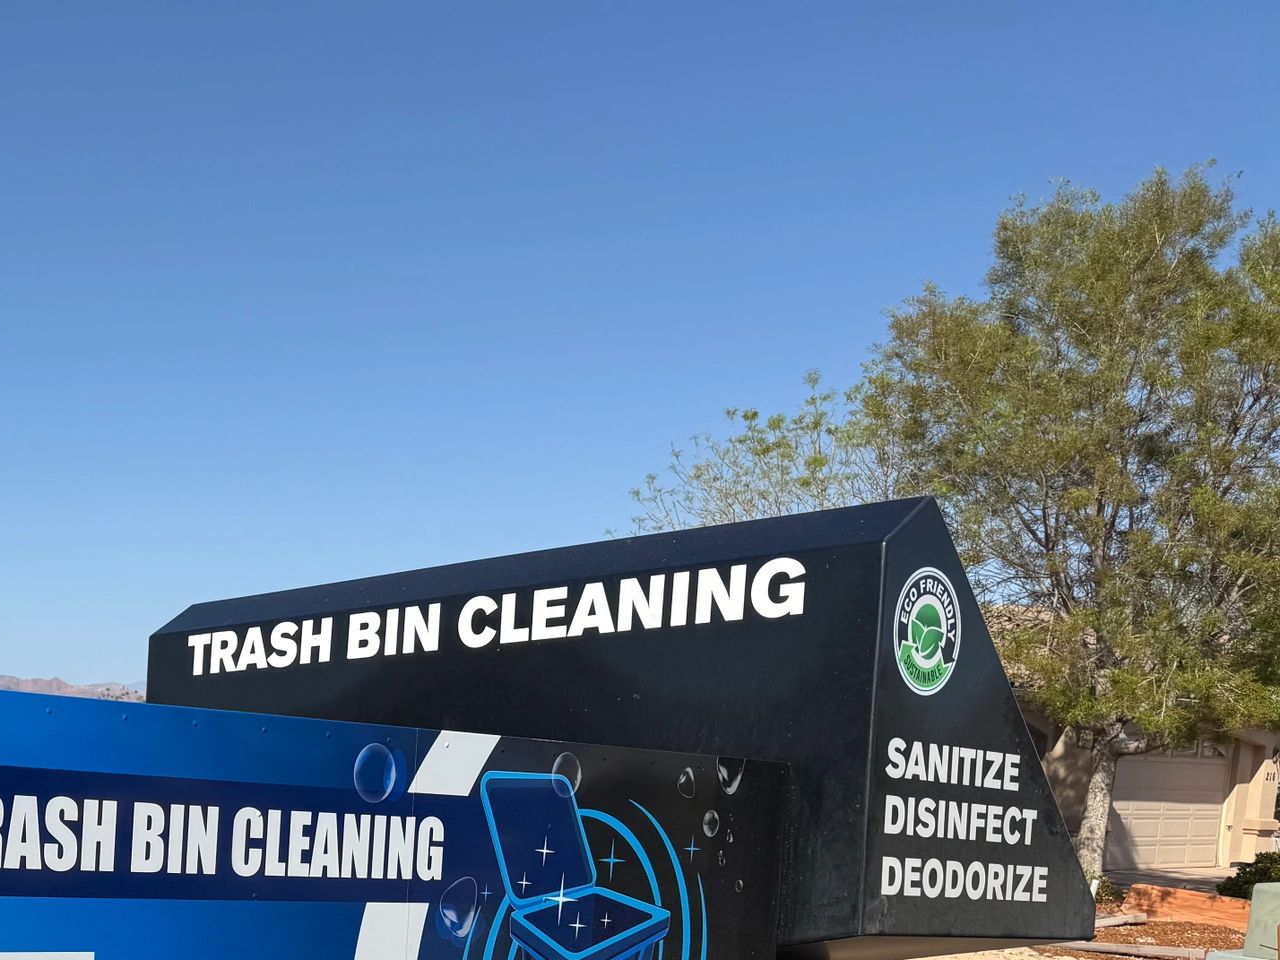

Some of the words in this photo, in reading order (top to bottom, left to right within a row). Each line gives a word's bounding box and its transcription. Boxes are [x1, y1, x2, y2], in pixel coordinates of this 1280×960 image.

[187, 616, 333, 676] TRASH
[346, 602, 441, 660] BIN
[457, 557, 807, 649] CLEANING
[900, 587, 918, 625] ECO
[919, 578, 956, 643] FRIENDLY
[903, 654, 943, 684] SUSTAINABLE
[884, 736, 1021, 792] SANITIZE
[130, 801, 220, 875] BIN
[231, 806, 446, 881] CLEANING
[883, 794, 1038, 846] DISINFECT
[880, 855, 1049, 903] DEODORIZE
